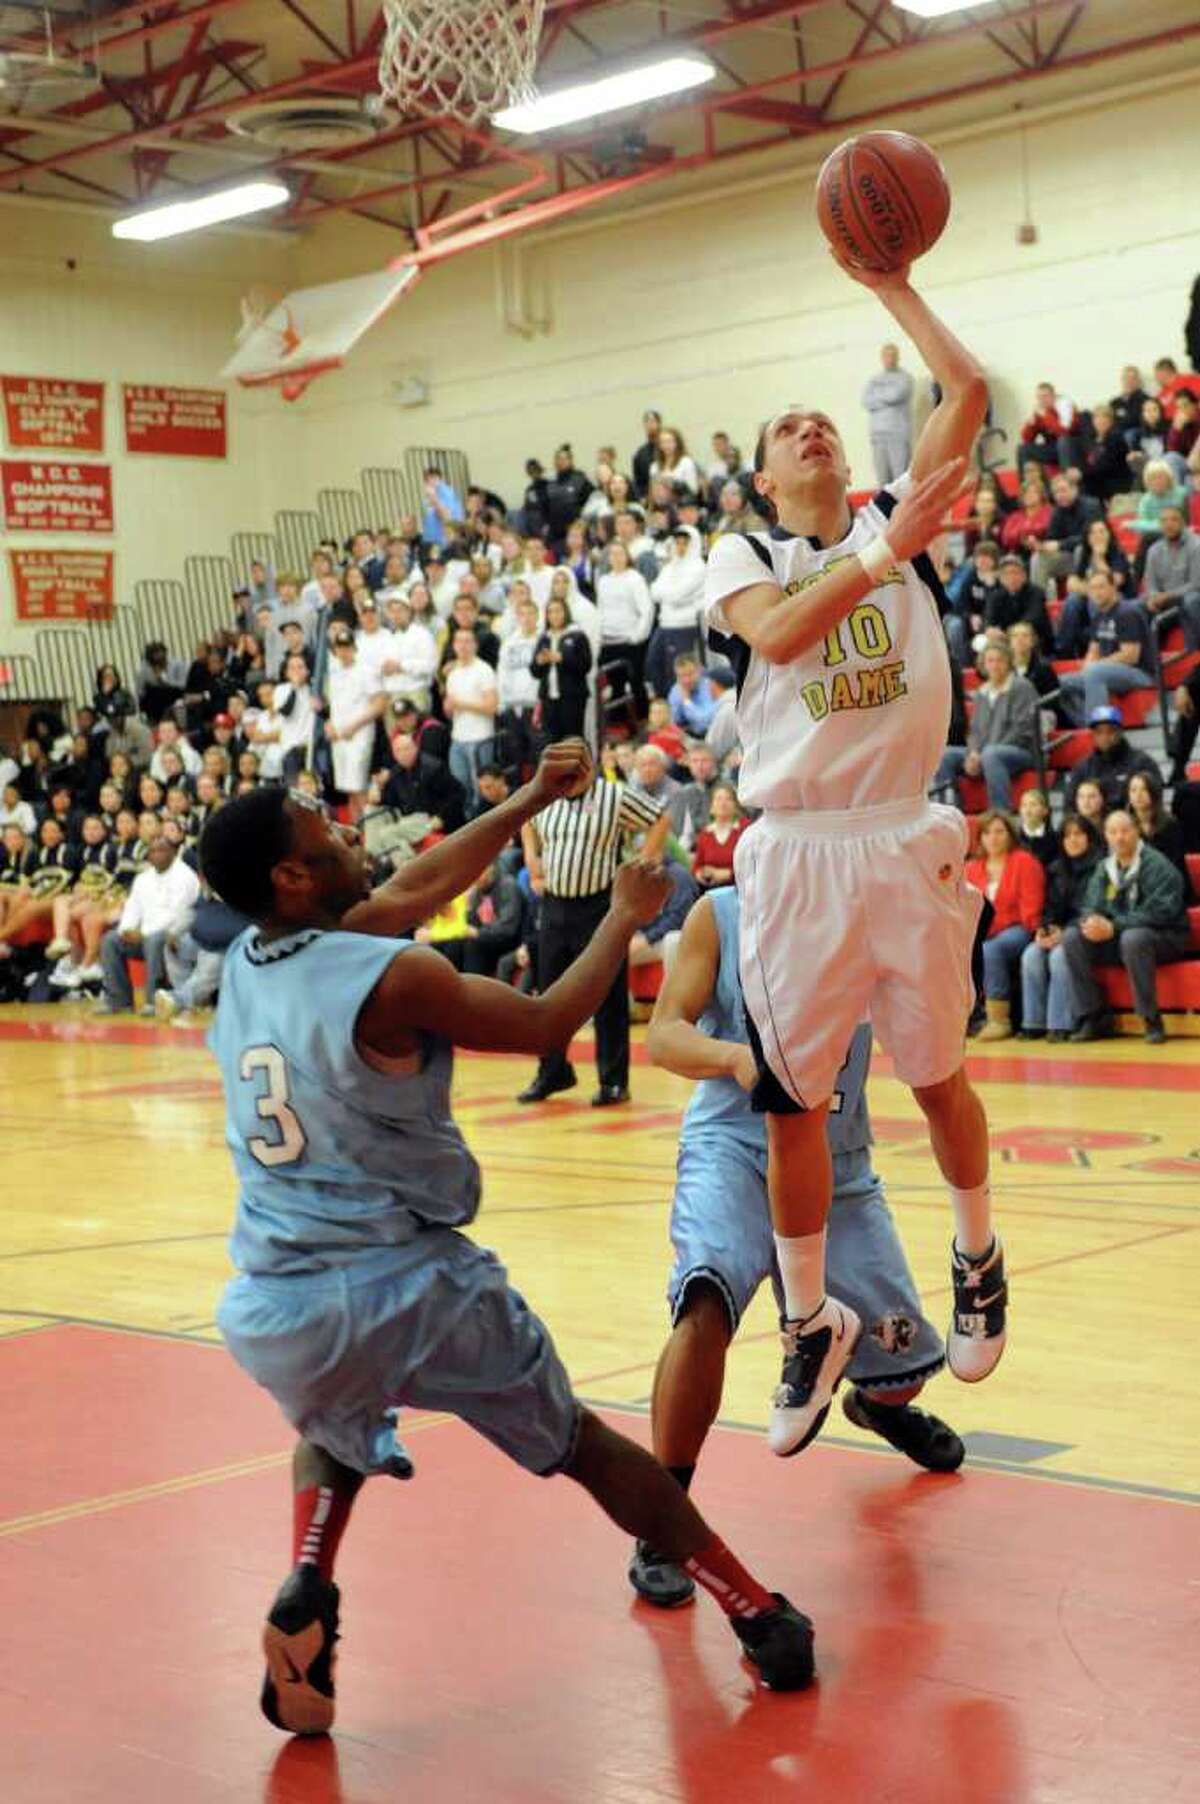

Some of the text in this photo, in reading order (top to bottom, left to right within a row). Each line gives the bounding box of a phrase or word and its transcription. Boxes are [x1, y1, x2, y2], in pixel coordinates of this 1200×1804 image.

[20, 418, 90, 434] SOFTBALL
[11, 481, 104, 500] CHAMPIONS
[14, 499, 104, 517] SOFTBALL
[27, 577, 98, 592] SOFTBALL
[824, 603, 893, 667] 10
[800, 660, 908, 723] DAME
[239, 1042, 309, 1169] 3
